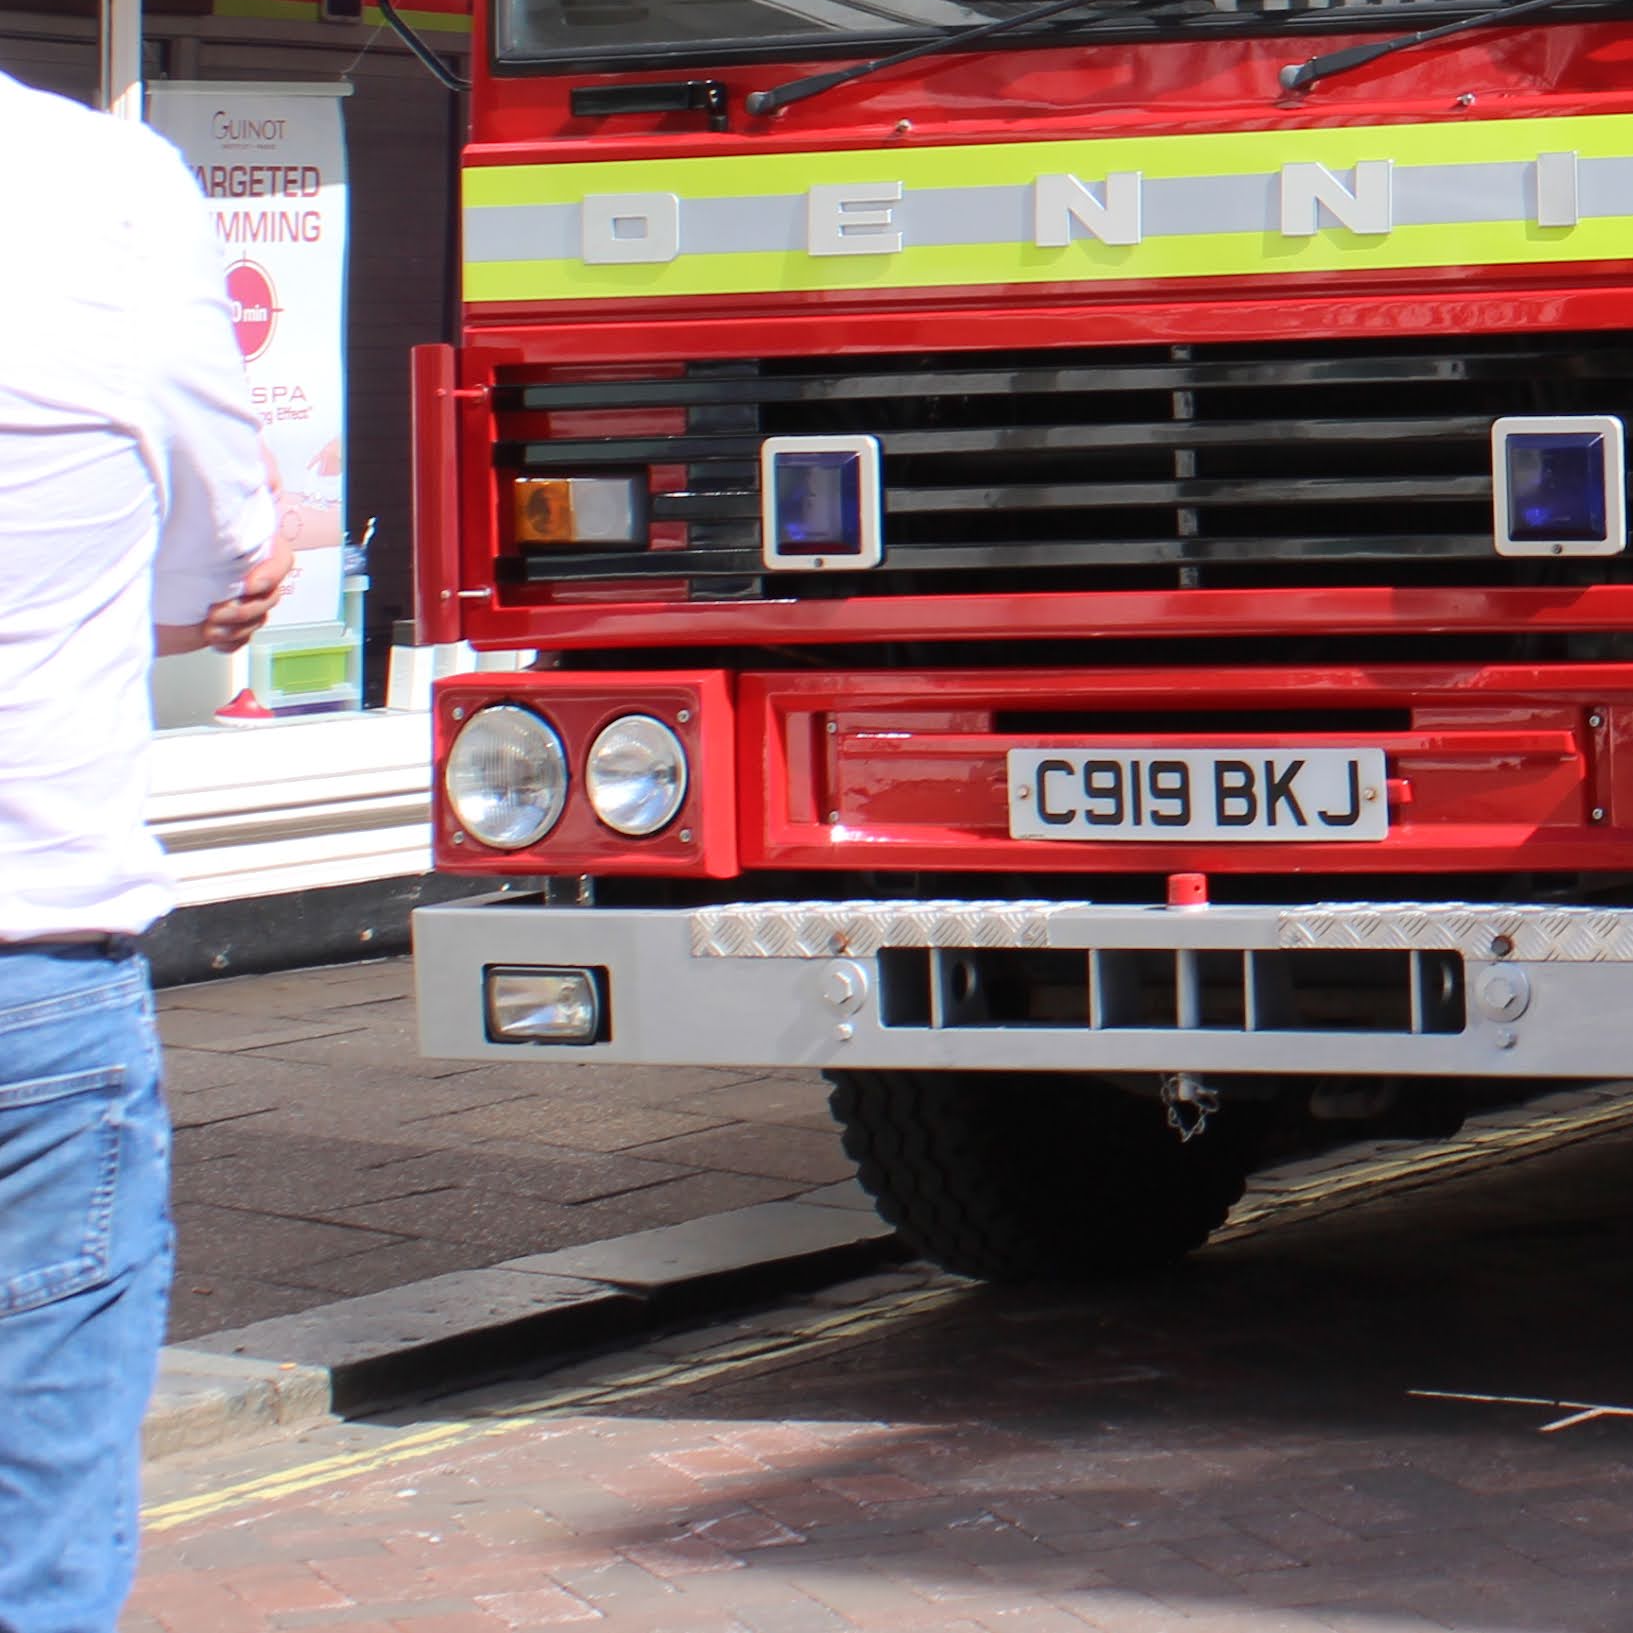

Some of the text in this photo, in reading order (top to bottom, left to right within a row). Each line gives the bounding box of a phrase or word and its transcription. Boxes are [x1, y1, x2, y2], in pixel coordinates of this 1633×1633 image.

[191, 165, 321, 198] ARGETED
[216, 210, 321, 243] MMING
[243, 304, 268, 322] min
[251, 385, 308, 404] SPA
[1036, 759, 1360, 827] C919 BKJ
